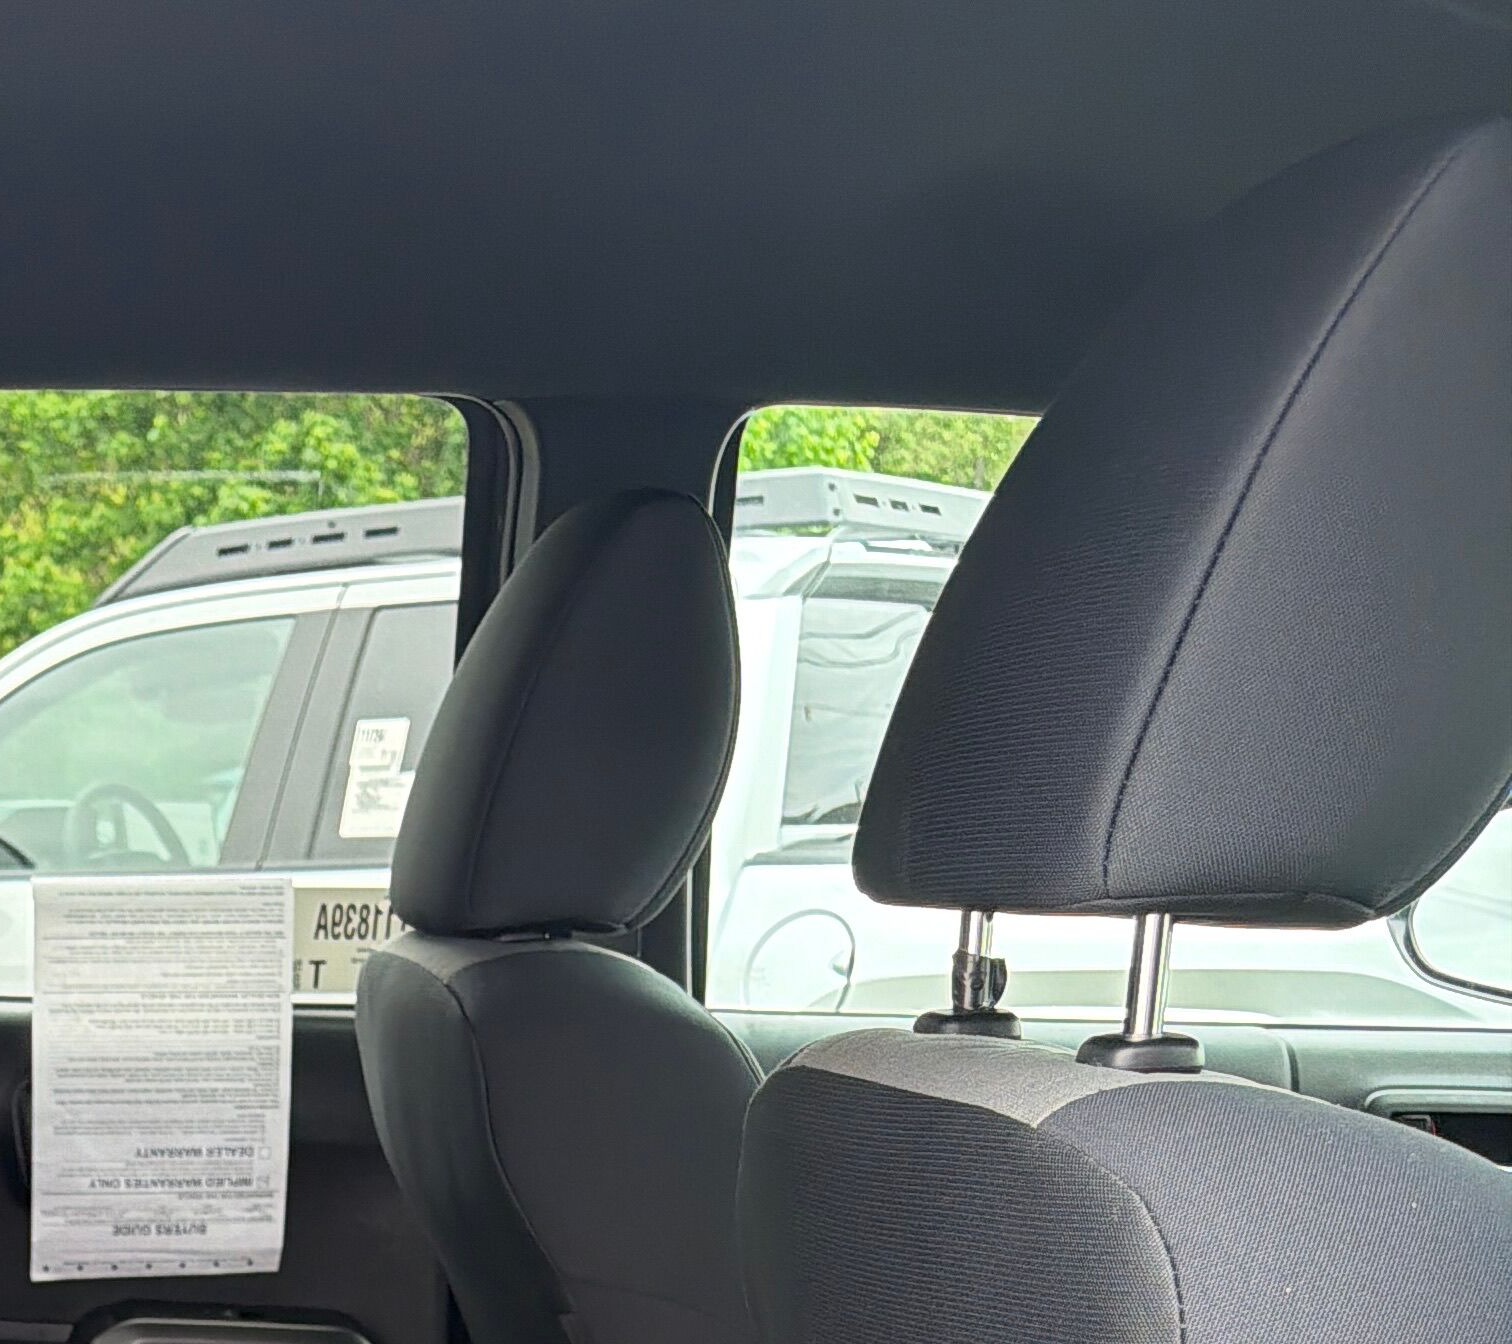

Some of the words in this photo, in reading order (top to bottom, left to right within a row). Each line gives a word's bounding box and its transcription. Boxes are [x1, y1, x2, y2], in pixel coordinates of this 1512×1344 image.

[134, 1147, 203, 1159] WARRANTY
[206, 1147, 255, 1158] DEALER
[88, 1178, 121, 1189] ONLY
[124, 1178, 203, 1189] WARRANTIES
[206, 1177, 254, 1188] IMPLIED
[112, 1224, 152, 1236] GUIDE
[155, 1224, 208, 1236] BUYERS
